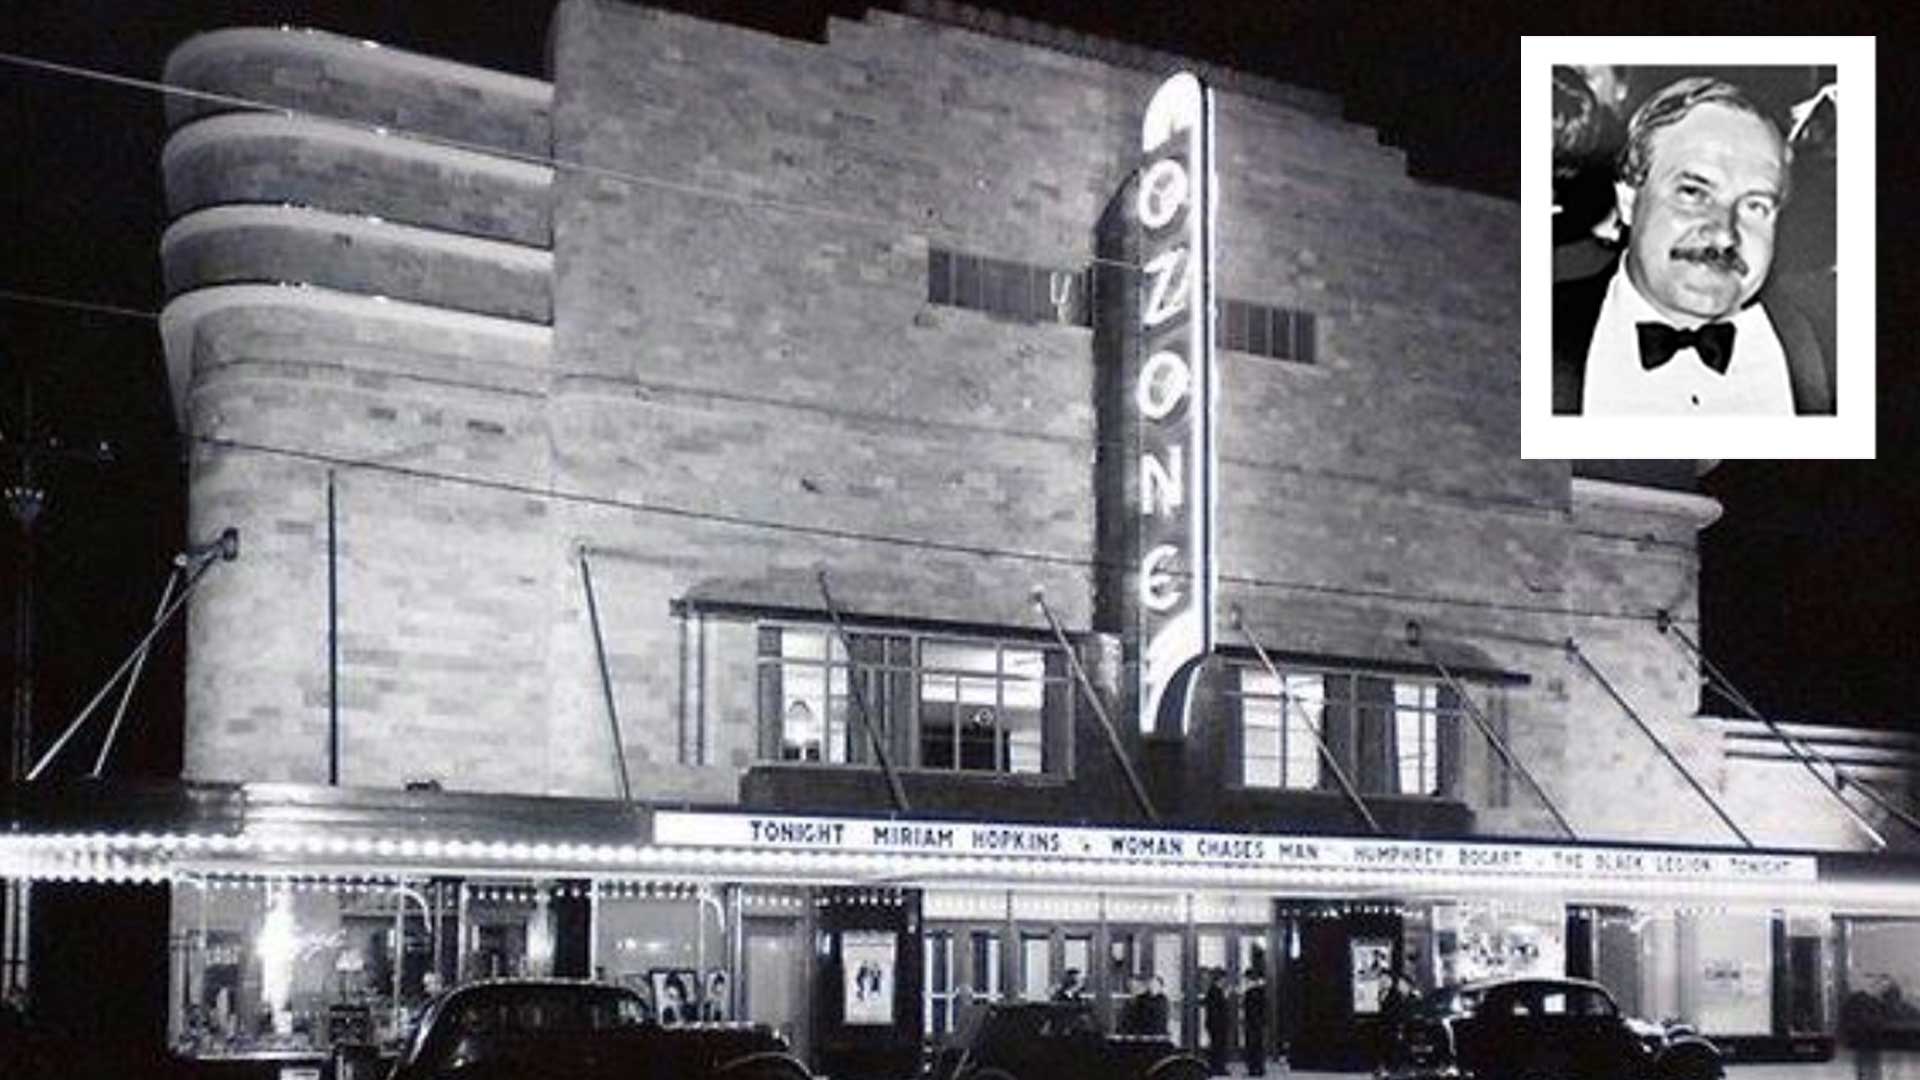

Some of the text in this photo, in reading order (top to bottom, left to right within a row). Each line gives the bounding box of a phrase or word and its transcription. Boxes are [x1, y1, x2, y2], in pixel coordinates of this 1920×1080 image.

[1137, 157, 1190, 612] OZONE
[748, 820, 845, 846] TONIGHT
[873, 826, 954, 849] MIRIAM
[971, 830, 1061, 853] HOPKINS
[1111, 836, 1183, 857] WOMAN
[1197, 839, 1265, 859] CHASES
[1279, 842, 1319, 860] MAN
[1353, 846, 1444, 866] HUMPHREY
[1458, 849, 1523, 867] BOGART
[1553, 852, 1583, 870] THE
[1595, 854, 1643, 872] BLACK
[1655, 855, 1711, 874] LEGION
